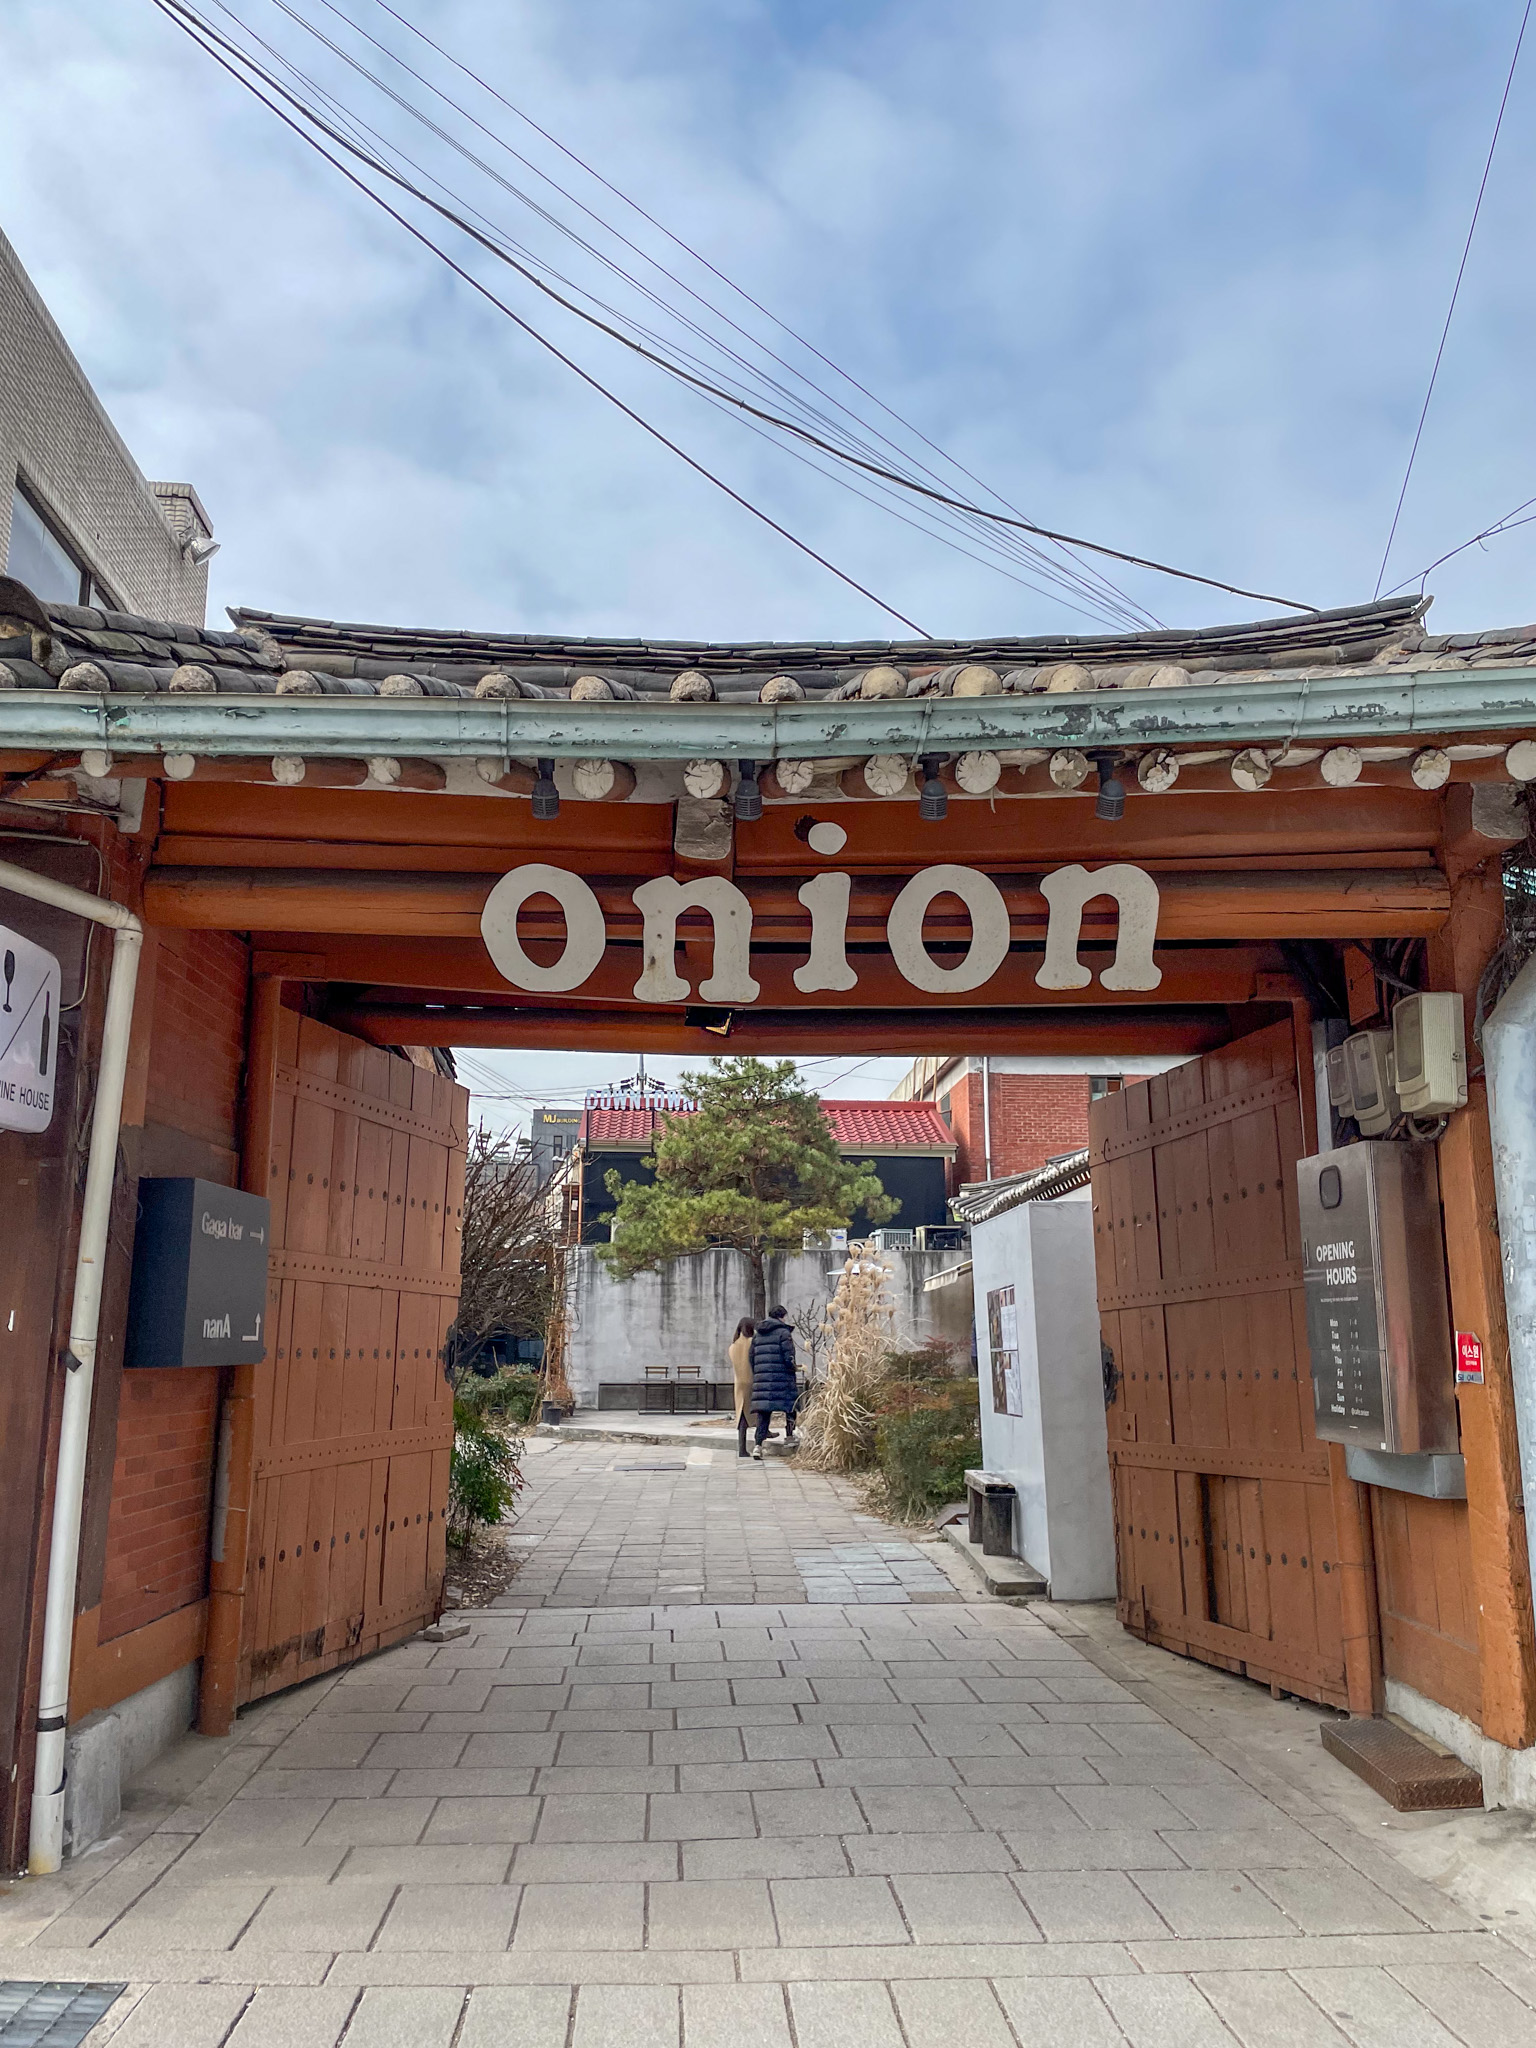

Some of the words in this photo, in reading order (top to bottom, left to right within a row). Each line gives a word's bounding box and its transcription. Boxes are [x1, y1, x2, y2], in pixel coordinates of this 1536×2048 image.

[480, 821, 1163, 1003] onion
[0, 1079, 16, 1102] INE
[19, 1086, 50, 1111] HOUSE
[543, 1114, 557, 1124] MJ
[1316, 1241, 1355, 1262] OPENING
[1326, 1266, 1357, 1286] HOURS
[202, 1313, 231, 1339] nanA
